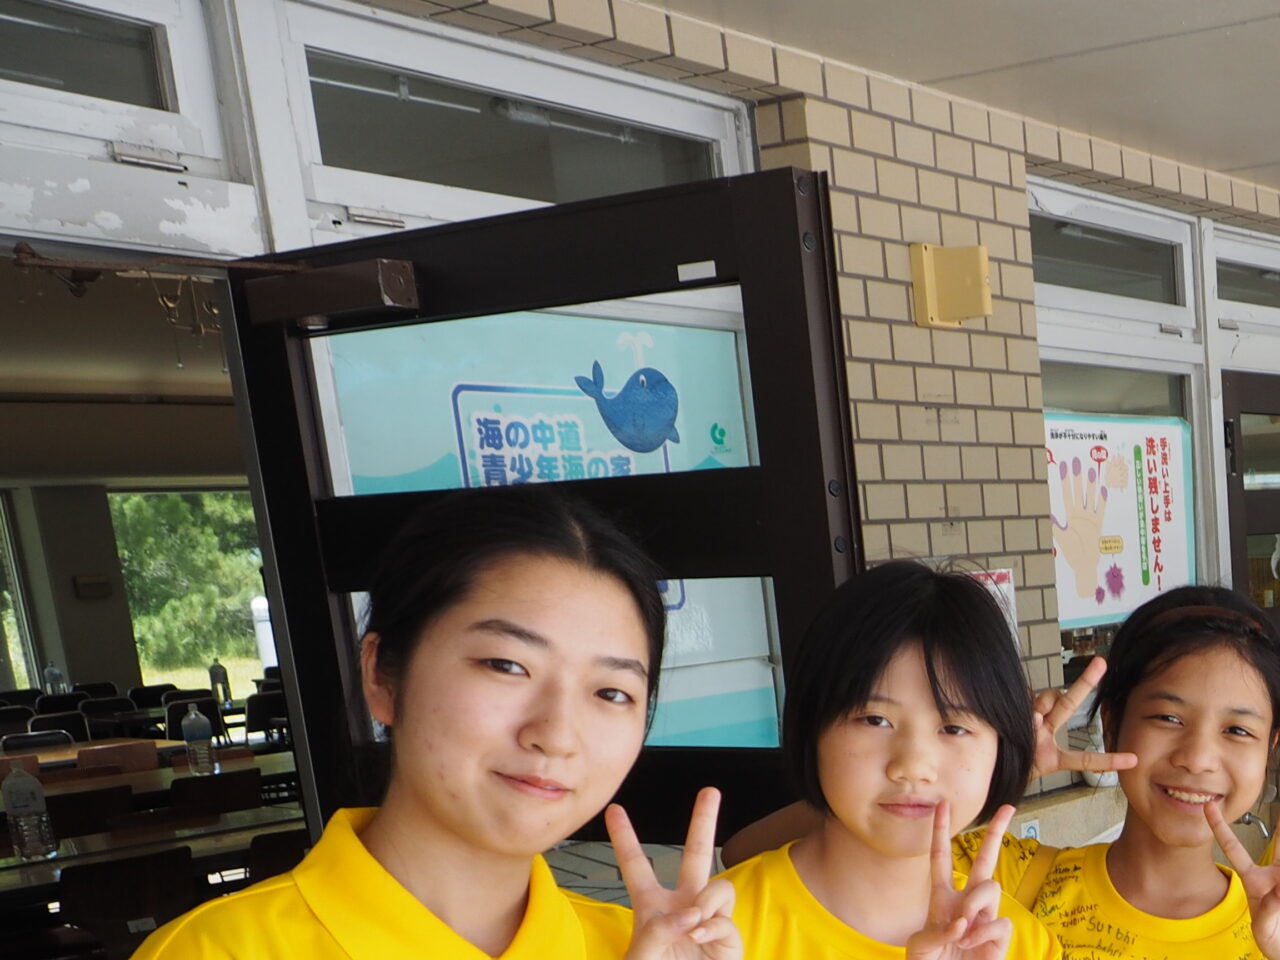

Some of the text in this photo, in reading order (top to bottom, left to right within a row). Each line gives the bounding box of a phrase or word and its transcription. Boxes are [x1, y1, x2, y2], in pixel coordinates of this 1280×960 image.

[476, 417, 582, 452] 海の中道
[480, 453, 632, 486] 青少年海の家
[1159, 437, 1172, 522] 手洗い上手は
